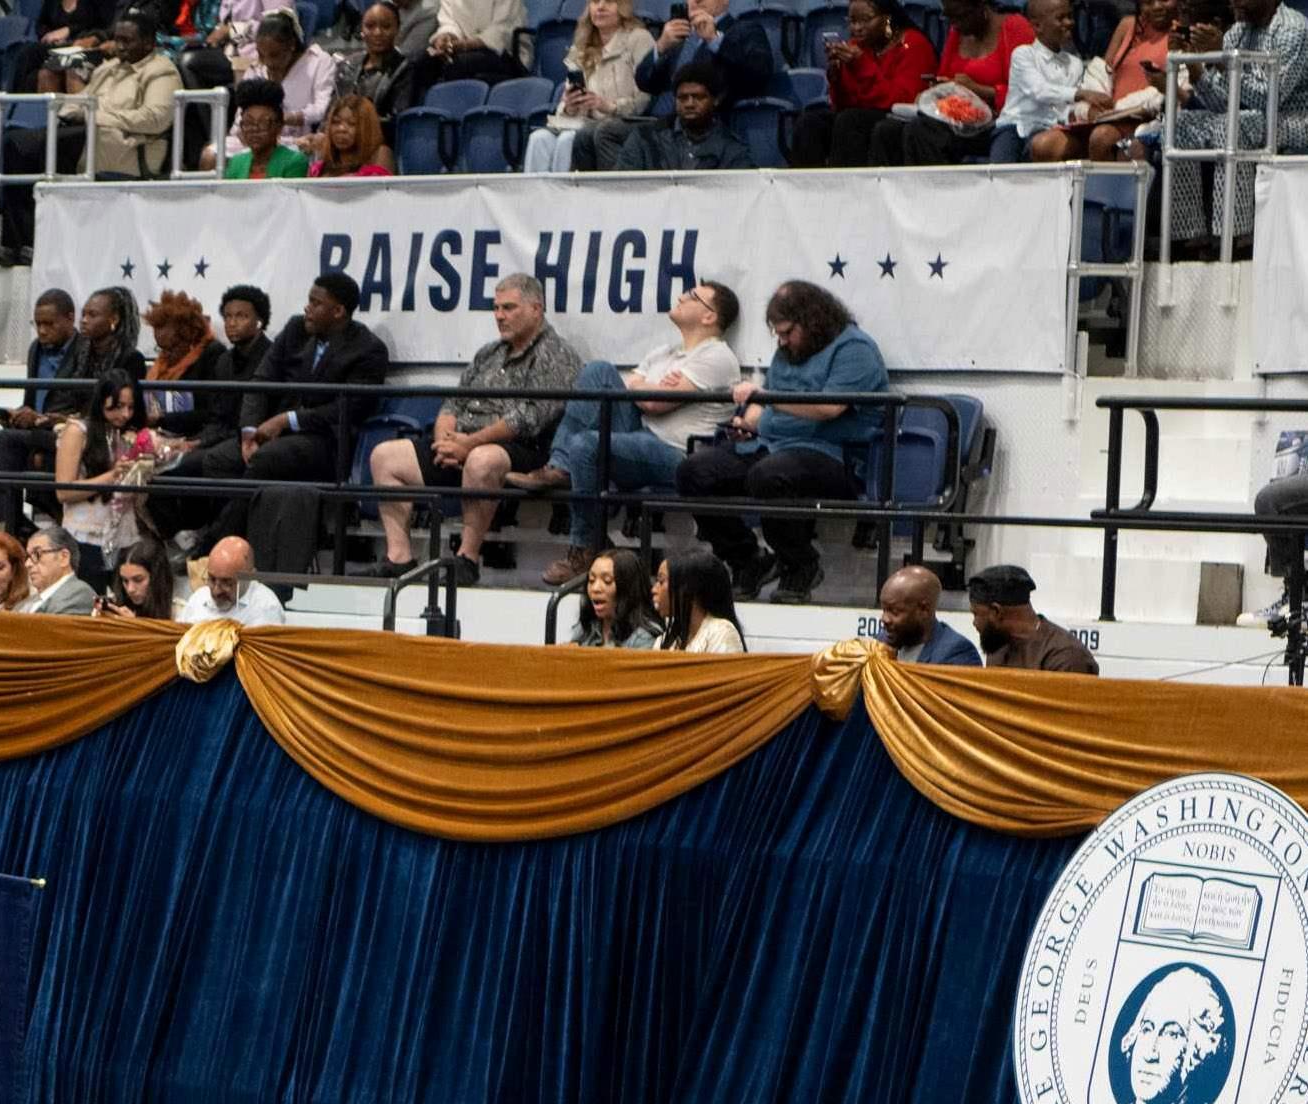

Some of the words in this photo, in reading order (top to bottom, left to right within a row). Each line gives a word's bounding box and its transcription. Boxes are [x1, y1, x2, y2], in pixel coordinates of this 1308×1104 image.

[319, 229, 502, 312] RAISE
[534, 229, 699, 313] HIGH
[1070, 630, 1099, 650] 09
[1182, 841, 1237, 863] NOBIS
[1029, 873, 1095, 1051] GEORGE
[1074, 958, 1098, 1025] DEUS
[1263, 967, 1294, 1065] FIDUCIA
